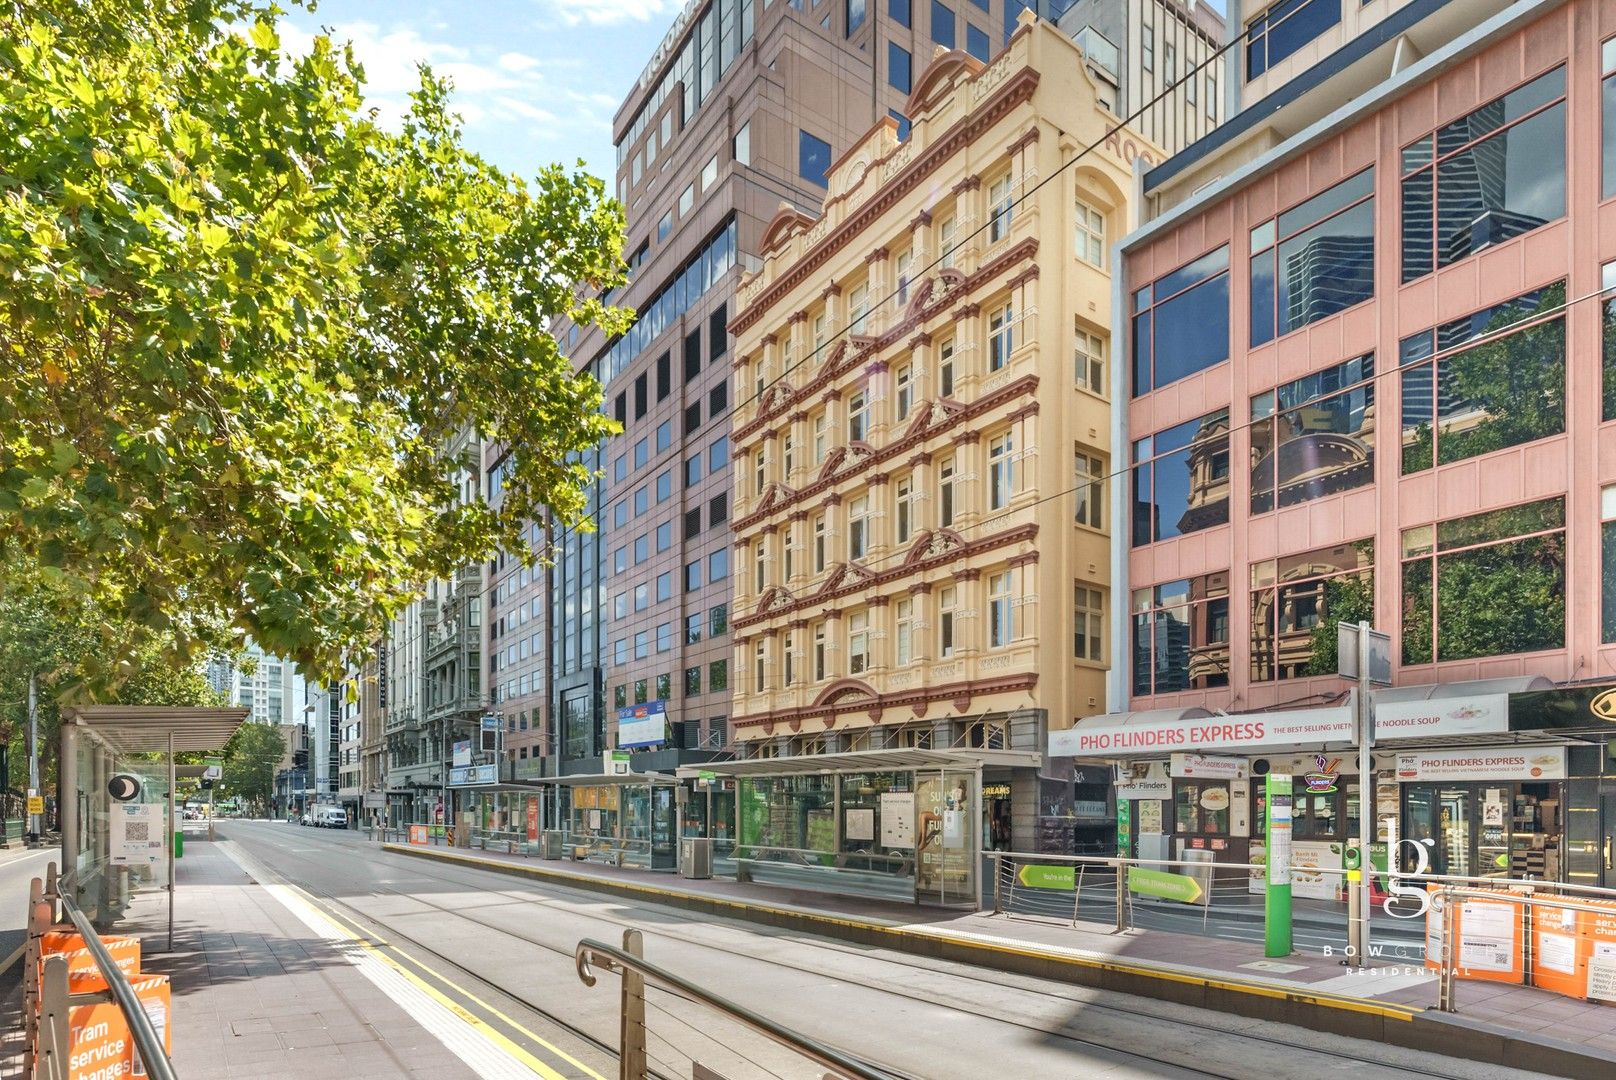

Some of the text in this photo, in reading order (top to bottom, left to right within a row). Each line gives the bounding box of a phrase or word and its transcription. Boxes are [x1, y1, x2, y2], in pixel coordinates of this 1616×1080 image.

[1273, 726, 1286, 734] THE
[1287, 725, 1303, 733] BEST
[1304, 724, 1331, 733] SELLING
[1383, 719, 1416, 728] NOODLE
[1417, 716, 1441, 725] SOUP
[1080, 722, 1265, 749] PHO FLINDERS EXPRESS
[1421, 756, 1525, 768] PHO FLINDERS EXPRESS
[1139, 781, 1167, 790] Flinders
[1595, 919, 1616, 928] serv
[72, 1022, 108, 1046] Tram
[69, 1039, 125, 1071] service
[78, 1059, 131, 1080] hanges
